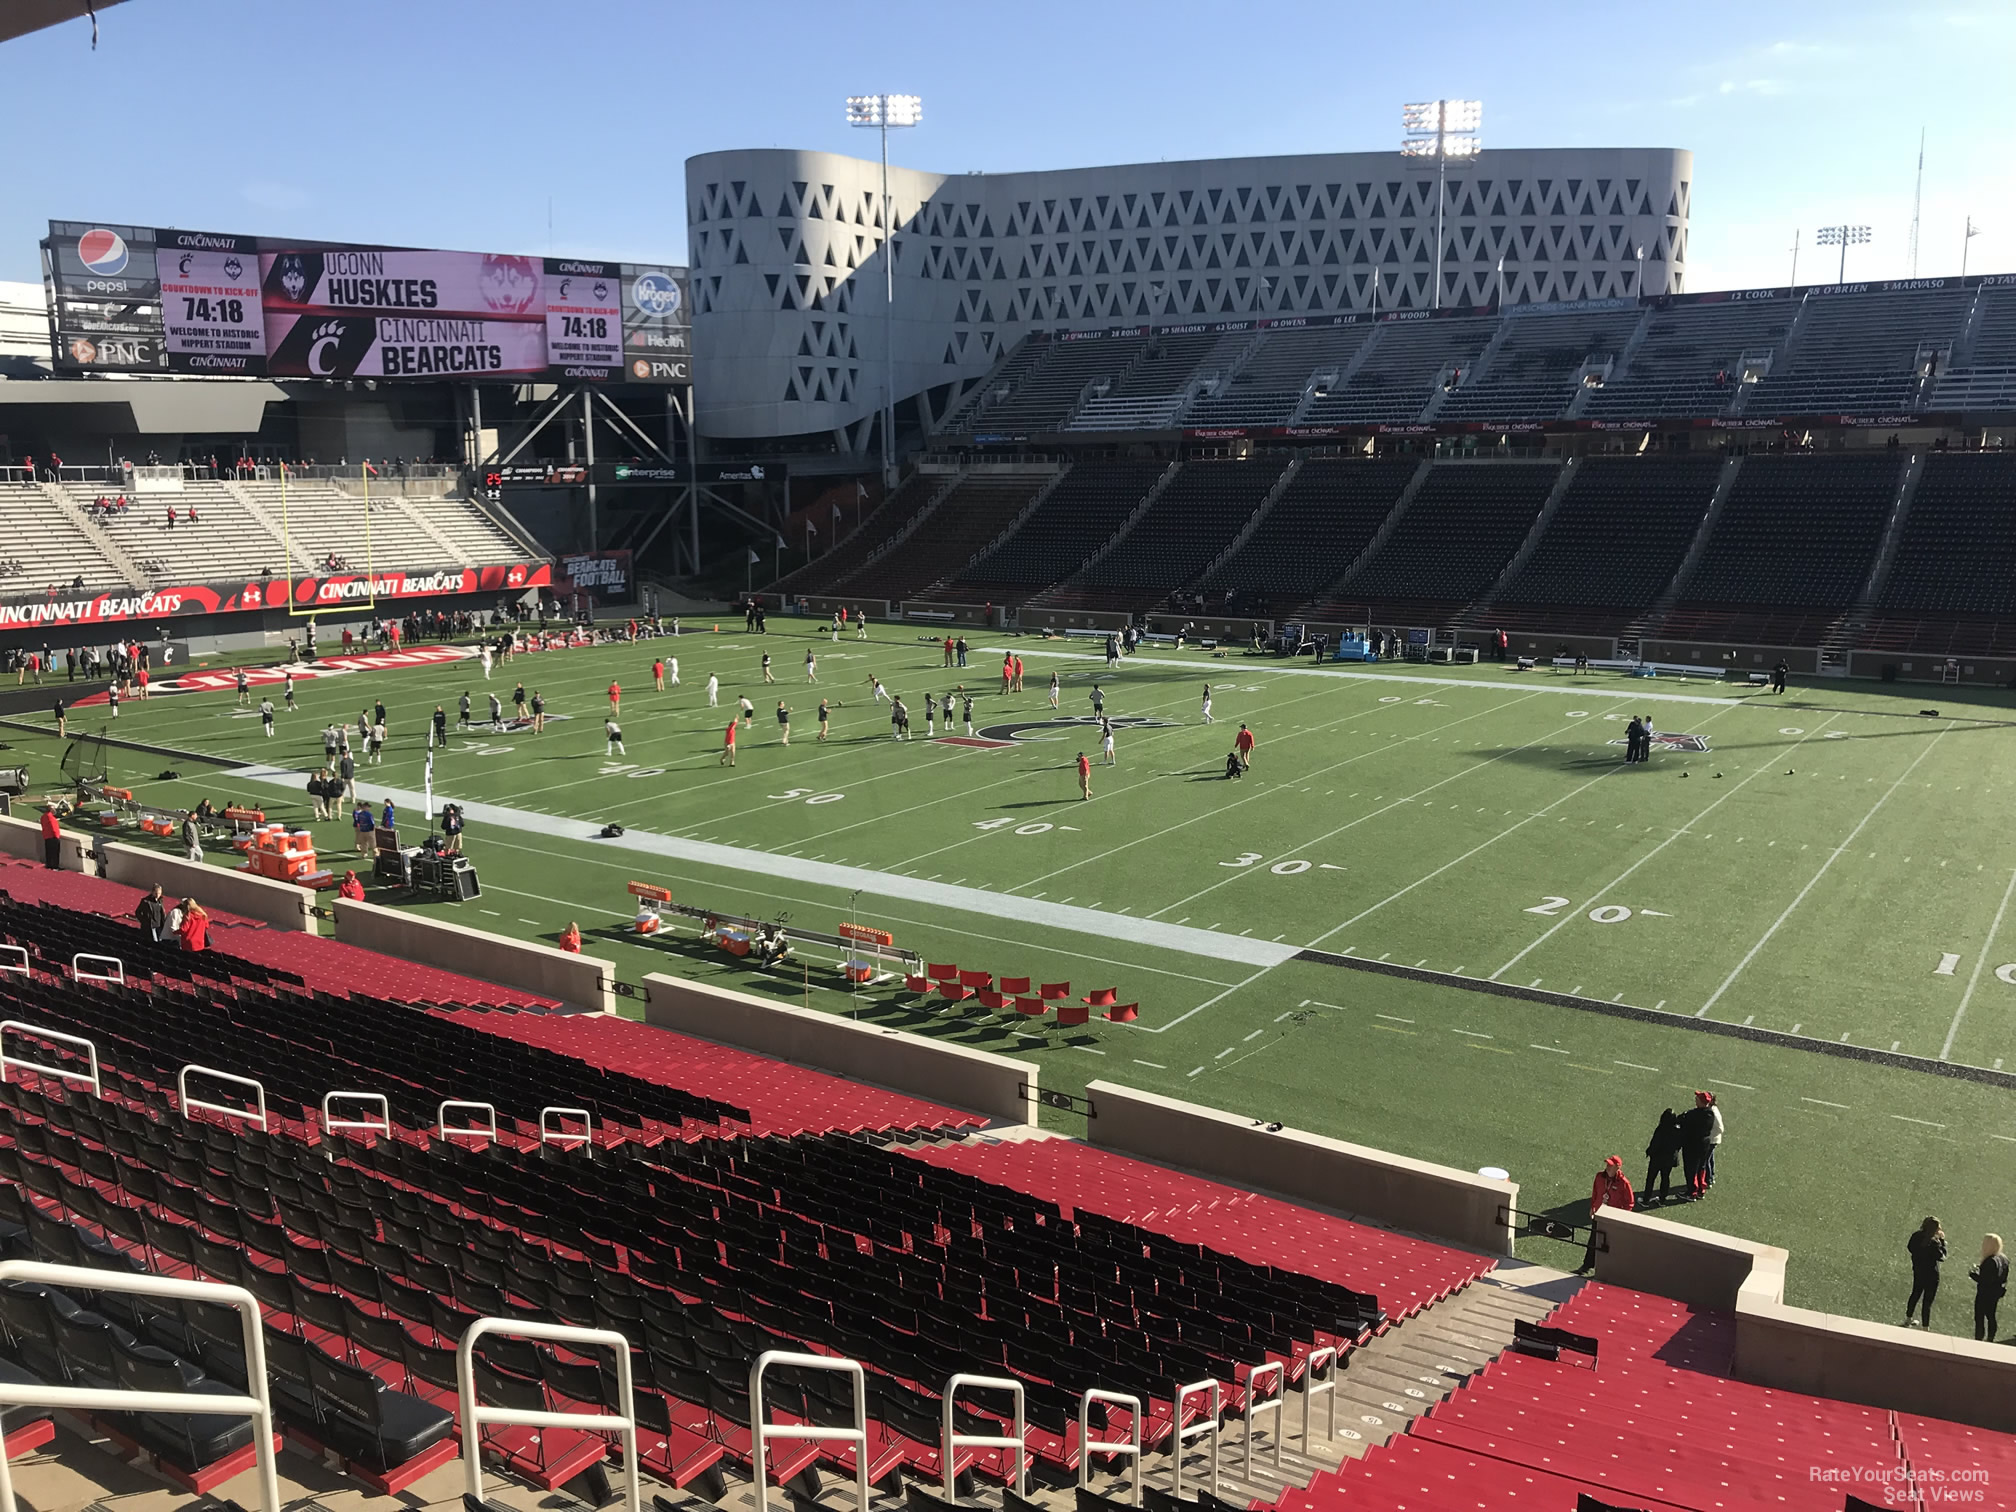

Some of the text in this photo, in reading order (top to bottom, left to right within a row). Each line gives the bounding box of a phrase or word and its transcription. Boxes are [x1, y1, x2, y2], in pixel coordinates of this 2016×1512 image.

[177, 233, 236, 248] CINCINNATI
[325, 252, 384, 276] UCONN
[559, 261, 604, 274] CINCINNATI
[87, 280, 128, 294] pepsi
[162, 283, 258, 297] COUNTDOWN TO KICK-OFF
[1807, 284, 1868, 296] 88 O'BRIEN
[1882, 279, 1945, 291] 5 MARVASO
[328, 278, 438, 309] HUSKIES
[638, 280, 676, 311] Kroger
[1745, 290, 1775, 299] COOK
[182, 297, 244, 323] 74:18
[1400, 311, 1430, 319] WOODS
[379, 318, 486, 343] CINCINNATI
[562, 316, 608, 339] 74:18
[1280, 319, 1307, 327] OWENS
[170, 326, 260, 339] WELCOME TO HISTORIC
[181, 339, 252, 350] NIPPERT STADIUM
[647, 334, 685, 348] Health
[98, 343, 151, 363] PNC
[189, 354, 247, 368] CINCINNATI
[382, 345, 502, 376] BEARCATS
[564, 366, 609, 378] CINCINNATI
[651, 362, 687, 378] PNC
[487, 473, 502, 486] 25
[616, 467, 676, 478] enterprise
[719, 471, 753, 480] Ameritas
[567, 559, 617, 575] BEARCATS
[318, 571, 464, 601] CINCINNATI BEARCATS
[573, 570, 626, 588] FOOTBALL
[0, 593, 182, 623] INCINNATI BEARCATS
[598, 761, 667, 779] 40
[767, 787, 846, 806] 50
[971, 816, 1057, 837] 40
[1217, 852, 1313, 875] 30
[1522, 896, 1633, 924] 20
